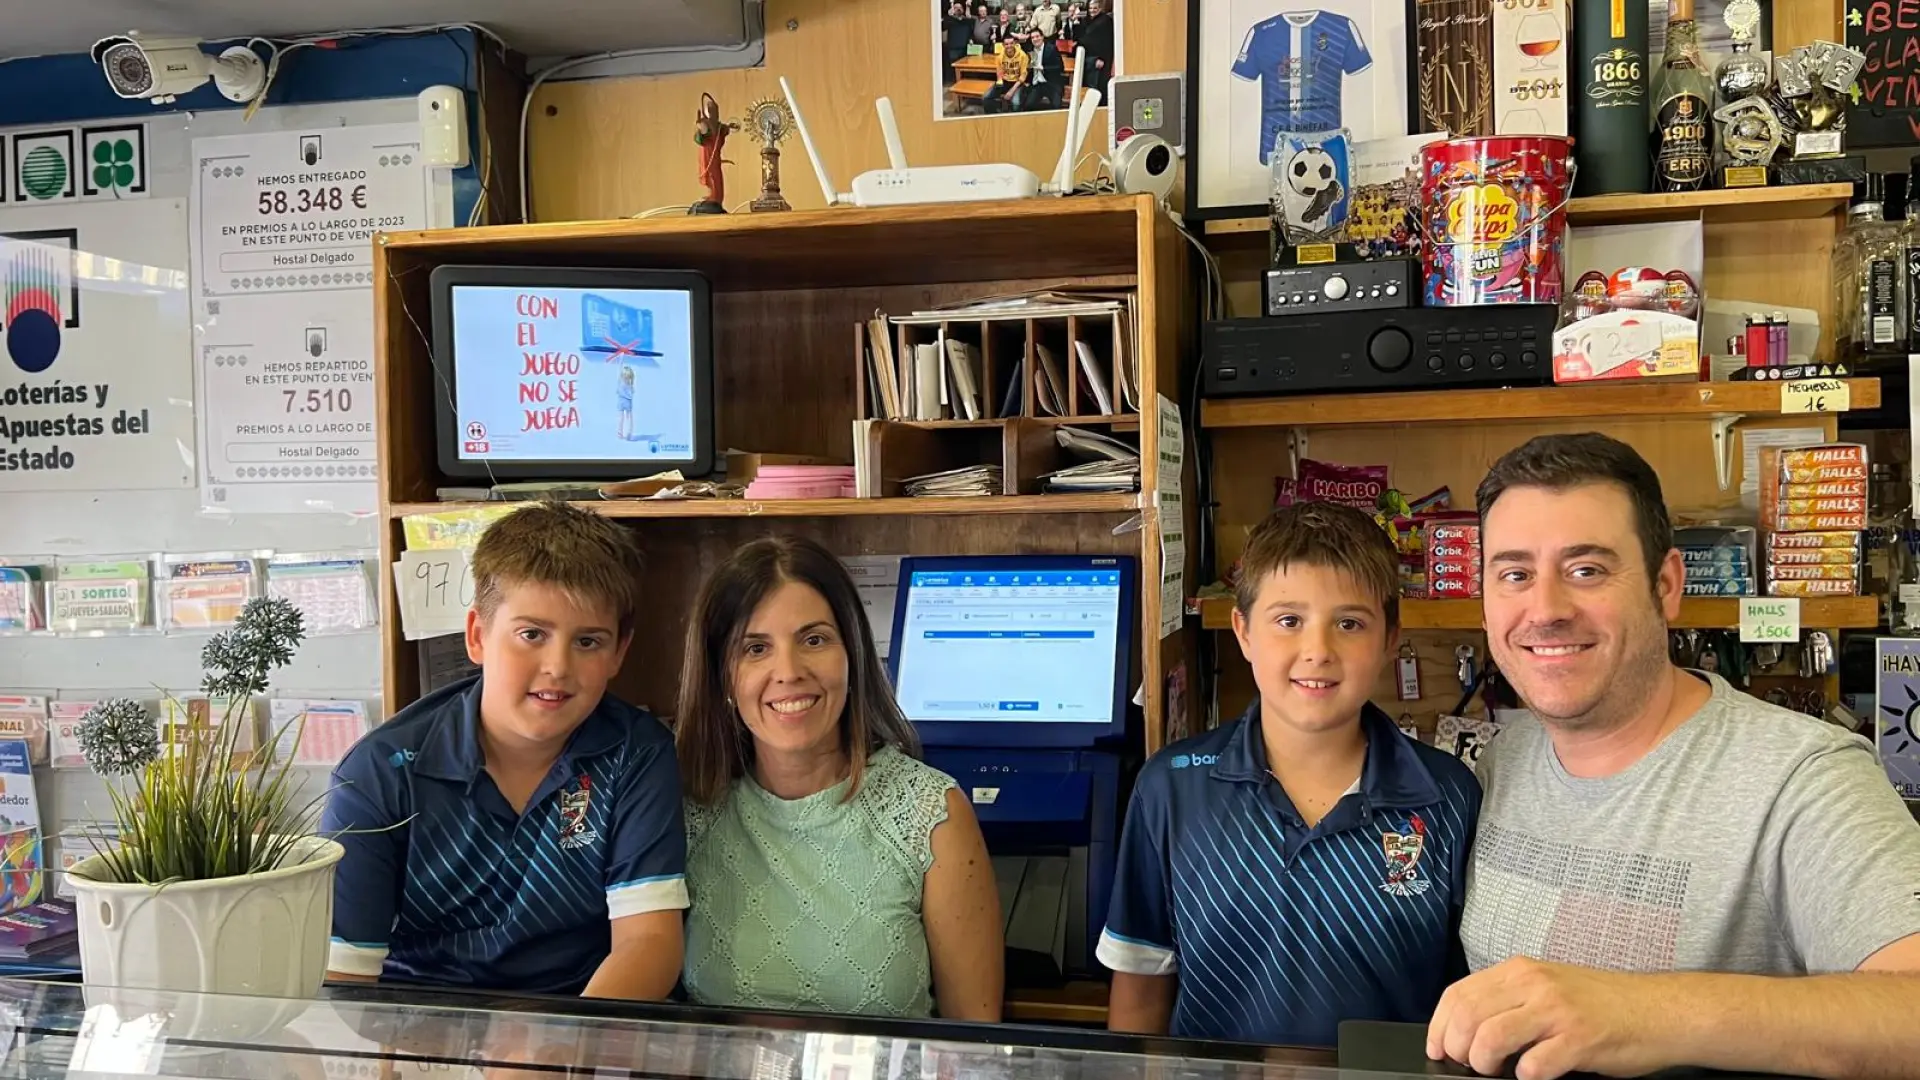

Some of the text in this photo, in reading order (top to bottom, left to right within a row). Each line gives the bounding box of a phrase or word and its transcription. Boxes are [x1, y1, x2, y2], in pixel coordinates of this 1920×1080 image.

[1420, 18, 1450, 31] Royal
[1594, 62, 1640, 82] 1866
[1441, 61, 1470, 116] N
[1510, 82, 1564, 93] BRANDY
[1662, 126, 1706, 141] 1900
[258, 170, 367, 186] HEMOS ENTREGADO
[258, 185, 368, 215] 58.348 €
[222, 216, 405, 236] EN PREMIOS A LO LARGO DE 2023
[242, 229, 383, 246] EN ESTE PUNTO DE VENT
[273, 252, 355, 266] Hostal Delgado
[516, 294, 558, 319] CON
[516, 322, 539, 347] EL
[264, 360, 368, 373] HEMOS REPARTIDO
[518, 351, 580, 376] JUEGO
[245, 372, 375, 385] EN ESTE PUNTO DE VEN
[0, 380, 108, 408] oterías y
[519, 380, 578, 404] NO SE
[283, 388, 352, 413] 7.510
[520, 407, 581, 432] JUEGA
[0, 408, 149, 444] Apuestas del
[236, 422, 372, 434] PREMIOS A LO LARGO DE
[279, 446, 360, 457] Hostal Delgado
[1813, 449, 1856, 461] HALLS
[1820, 466, 1862, 478] HALLS
[1313, 479, 1381, 499] HARIBO
[1816, 483, 1859, 495] HALLS
[1816, 499, 1859, 511] HALLS
[1816, 516, 1859, 527] HALLS
[1434, 528, 1463, 540] Orbit
[1778, 537, 1823, 547] HALLS
[1434, 546, 1462, 557] Orbit
[1681, 550, 1713, 561] HALL
[1777, 552, 1823, 563] HALLS
[1434, 563, 1463, 575] Orbit
[1778, 567, 1823, 578] HALLS
[1434, 579, 1463, 591] Orbit
[1684, 583, 1719, 594] HALL
[1805, 581, 1850, 593] HALLS
[82, 587, 127, 599] SORTEO
[1748, 605, 1785, 617] HALLS
